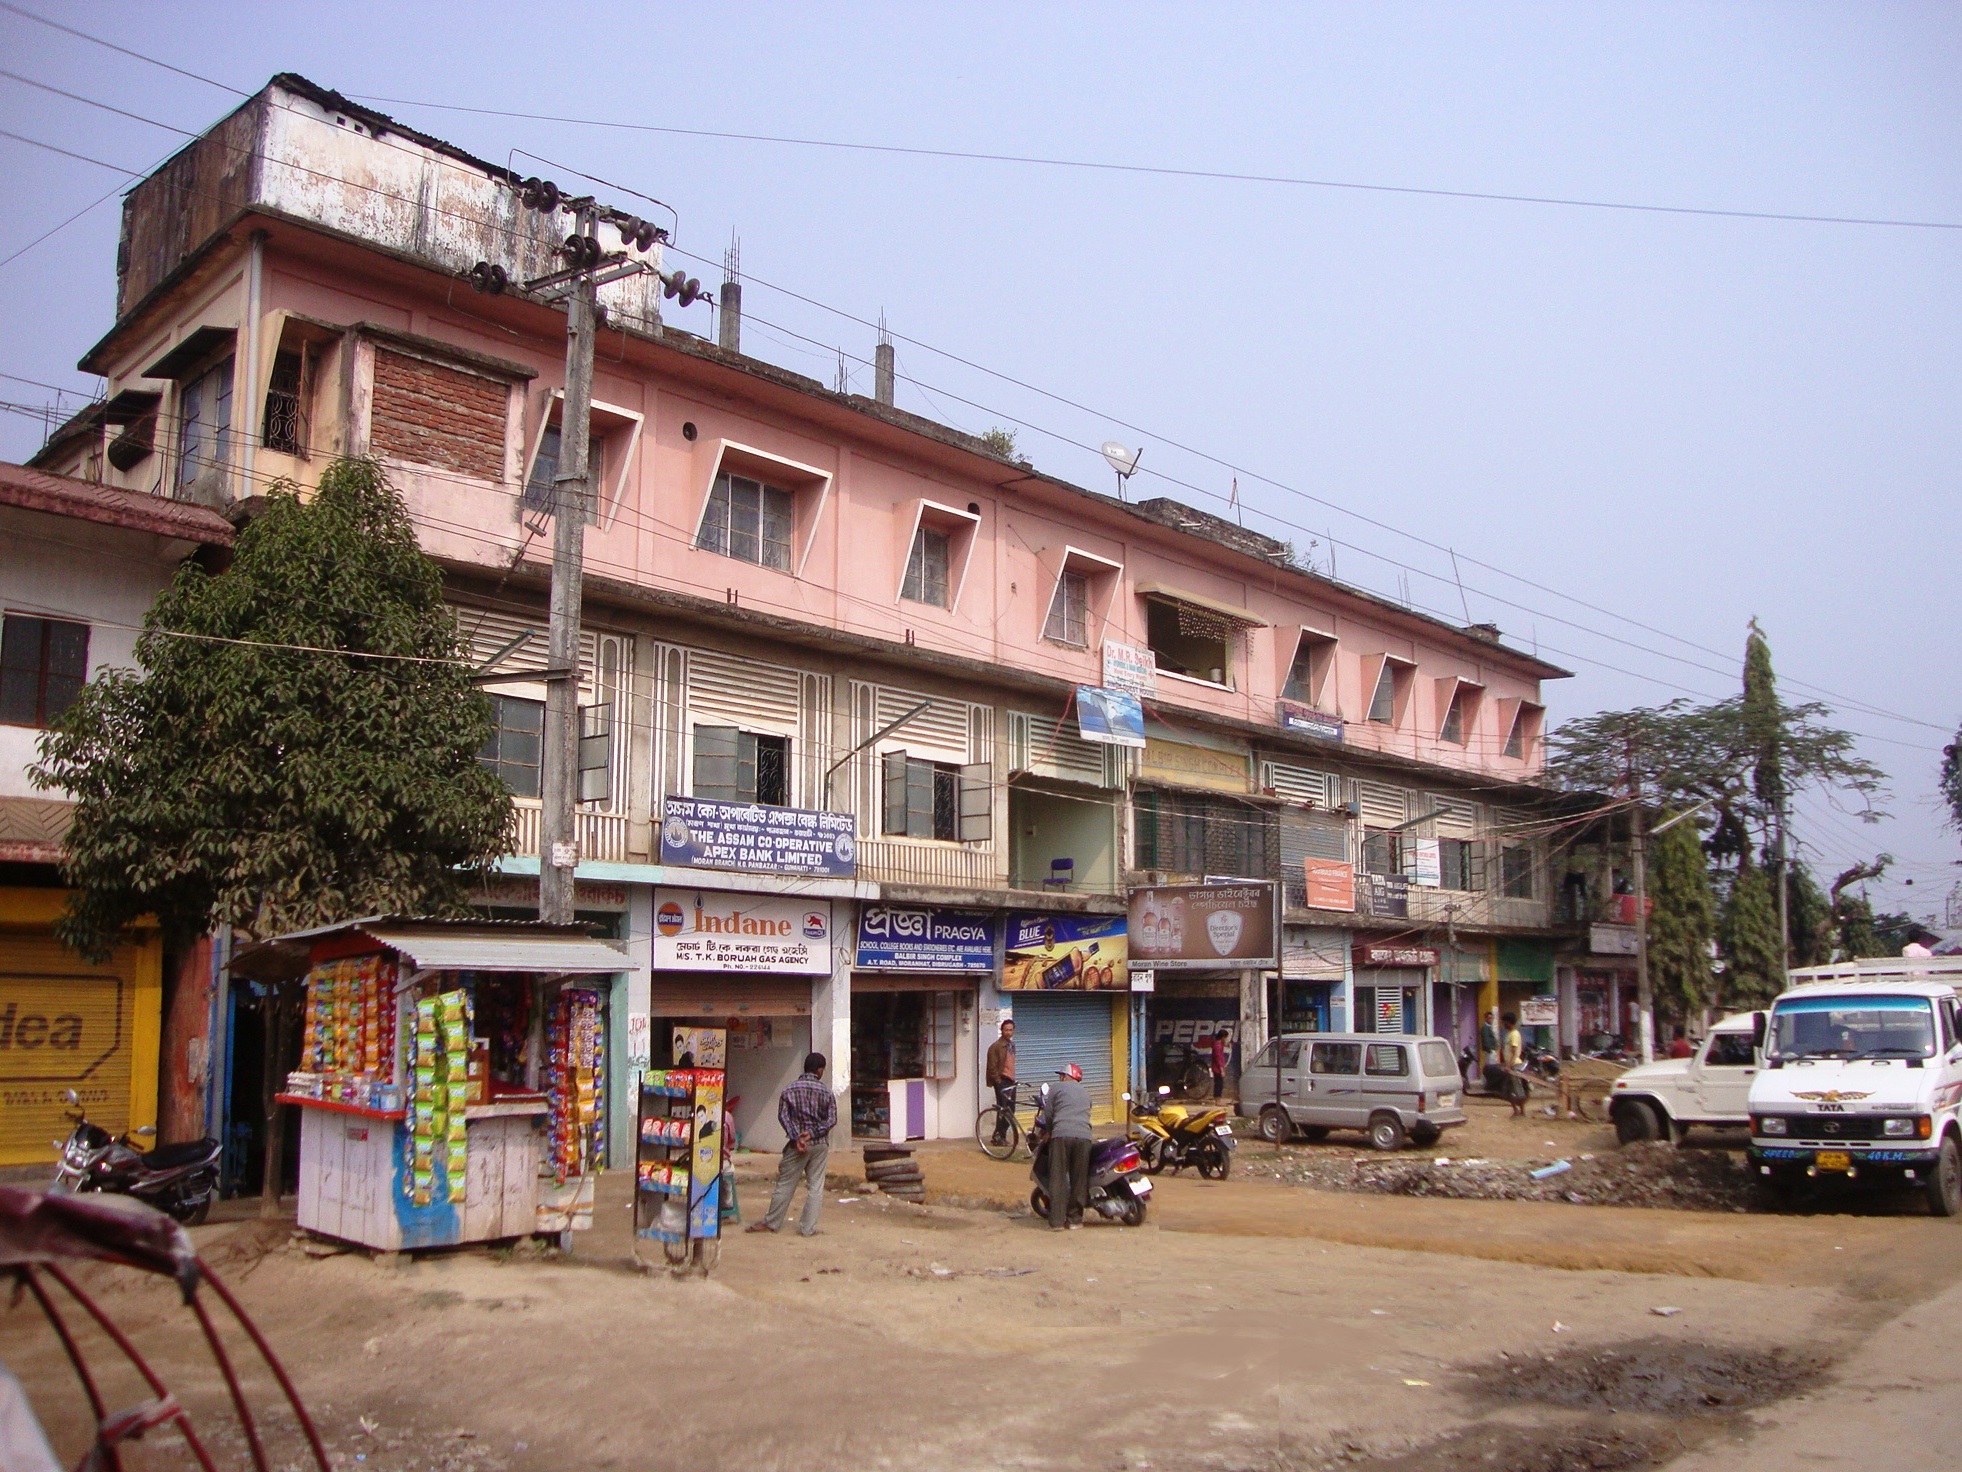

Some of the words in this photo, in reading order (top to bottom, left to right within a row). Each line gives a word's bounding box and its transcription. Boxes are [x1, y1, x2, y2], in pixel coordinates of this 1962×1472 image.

[690, 829, 714, 843] THE
[717, 832, 755, 847] ASSAM
[703, 845, 737, 860] APEX
[739, 848, 773, 863] BANK
[776, 851, 823, 866] LIMITED
[694, 908, 791, 936] Indane
[934, 925, 986, 940] PRAGYA
[1019, 925, 1041, 941] BLUE
[880, 942, 899, 950] COLLEGE
[717, 954, 757, 962] BORUAH
[894, 952, 916, 960] BALBIR
[1154, 1020, 1239, 1042] PEPSI
[1817, 1104, 1844, 1112] TATA
[1763, 1150, 1794, 1158] SPEED
